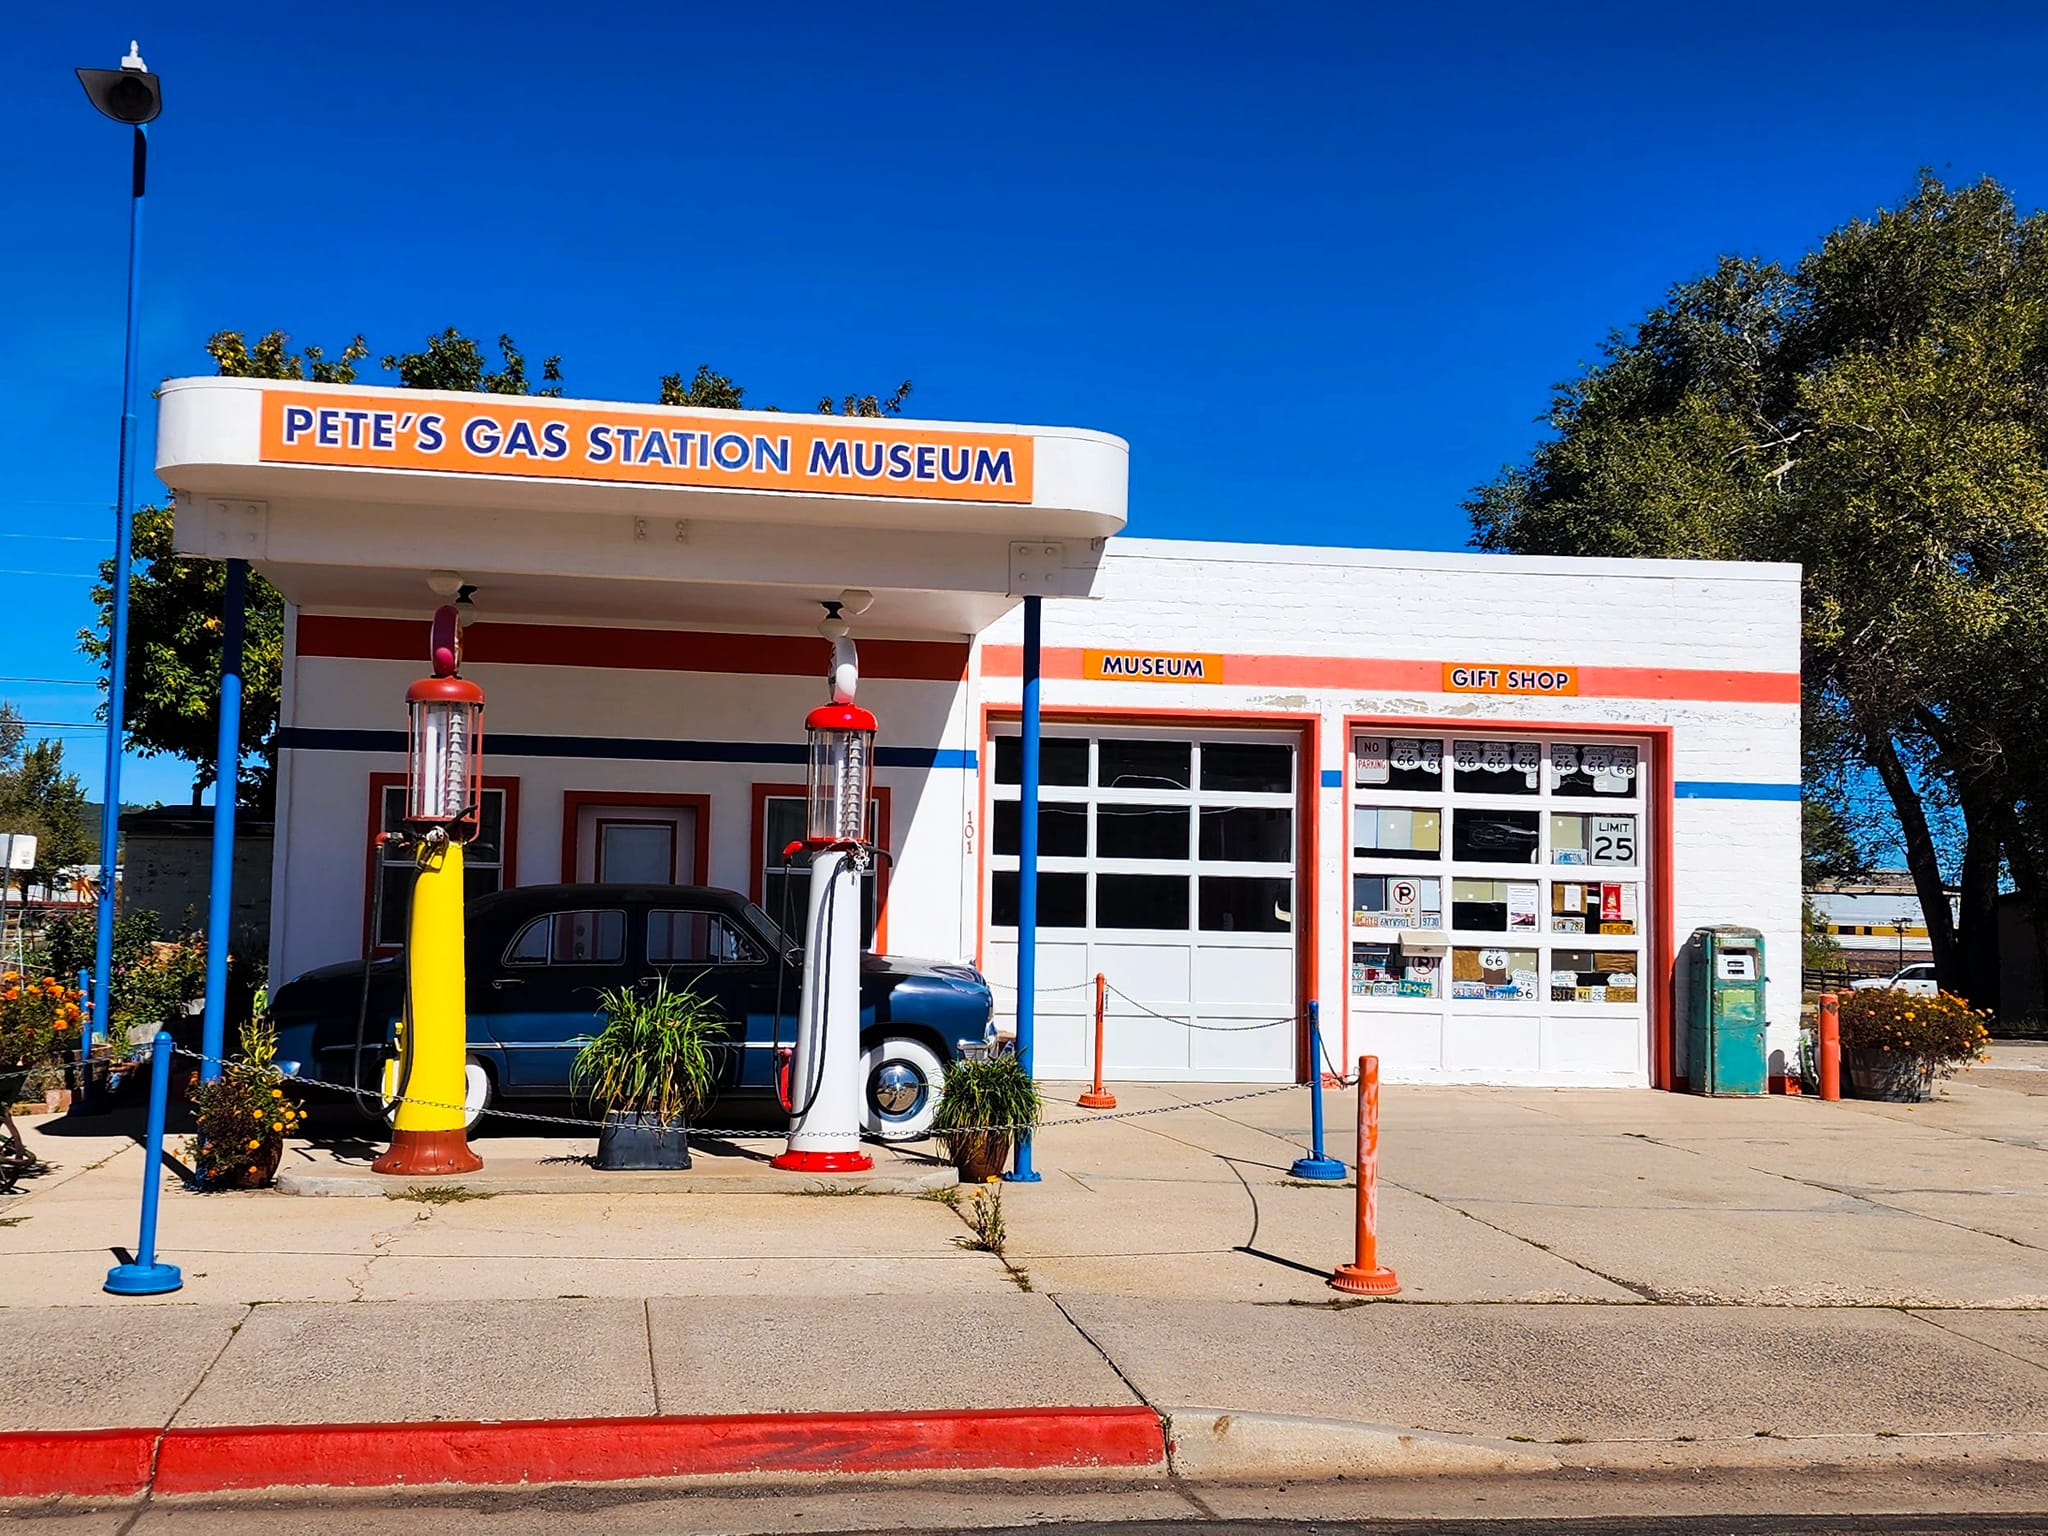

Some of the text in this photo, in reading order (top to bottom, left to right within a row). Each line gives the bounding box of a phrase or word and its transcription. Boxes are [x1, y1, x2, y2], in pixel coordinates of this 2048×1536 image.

[284, 406, 1017, 485] PETE'S GAS STATION MUSEUM
[1103, 656, 1203, 677] MUSEUM
[1452, 669, 1569, 689] GIFT SHOP
[1364, 742, 1379, 753] NO
[1358, 759, 1386, 769] PARKING
[1397, 755, 1415, 766] 66
[1459, 757, 1476, 768] 66
[1488, 758, 1506, 769] 66
[1520, 758, 1537, 769] 66
[1555, 760, 1573, 771] 66
[1588, 761, 1606, 772] 66
[1617, 764, 1634, 776] 66
[964, 809, 975, 855] 101
[1599, 822, 1630, 833] LIMIT
[1595, 836, 1634, 861] 25
[1485, 955, 1504, 967] 66
[1517, 987, 1534, 999] 66
